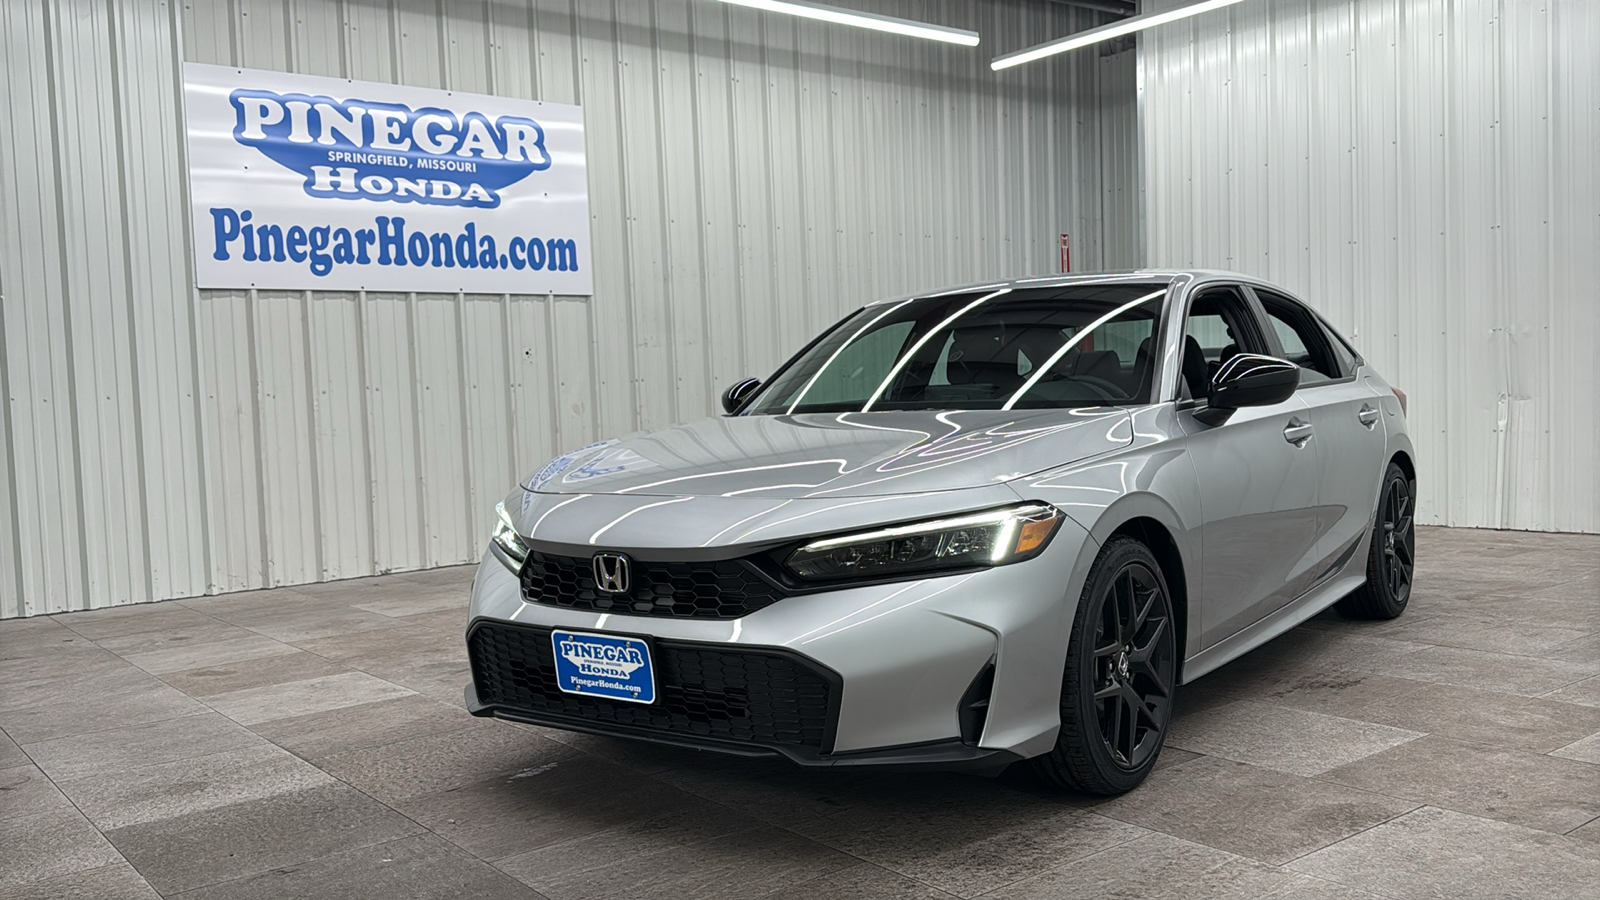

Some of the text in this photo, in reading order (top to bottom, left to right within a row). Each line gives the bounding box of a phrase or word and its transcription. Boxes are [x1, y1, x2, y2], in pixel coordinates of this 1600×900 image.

[236, 96, 546, 165] PINEGAR
[327, 150, 477, 173] SPRINGFIELD, MISSOURI
[309, 165, 495, 202] HONDA
[209, 207, 579, 277] PinegarHonda.com
[561, 643, 642, 665] PINEGAR
[570, 676, 642, 693] PinegarHonda.com
